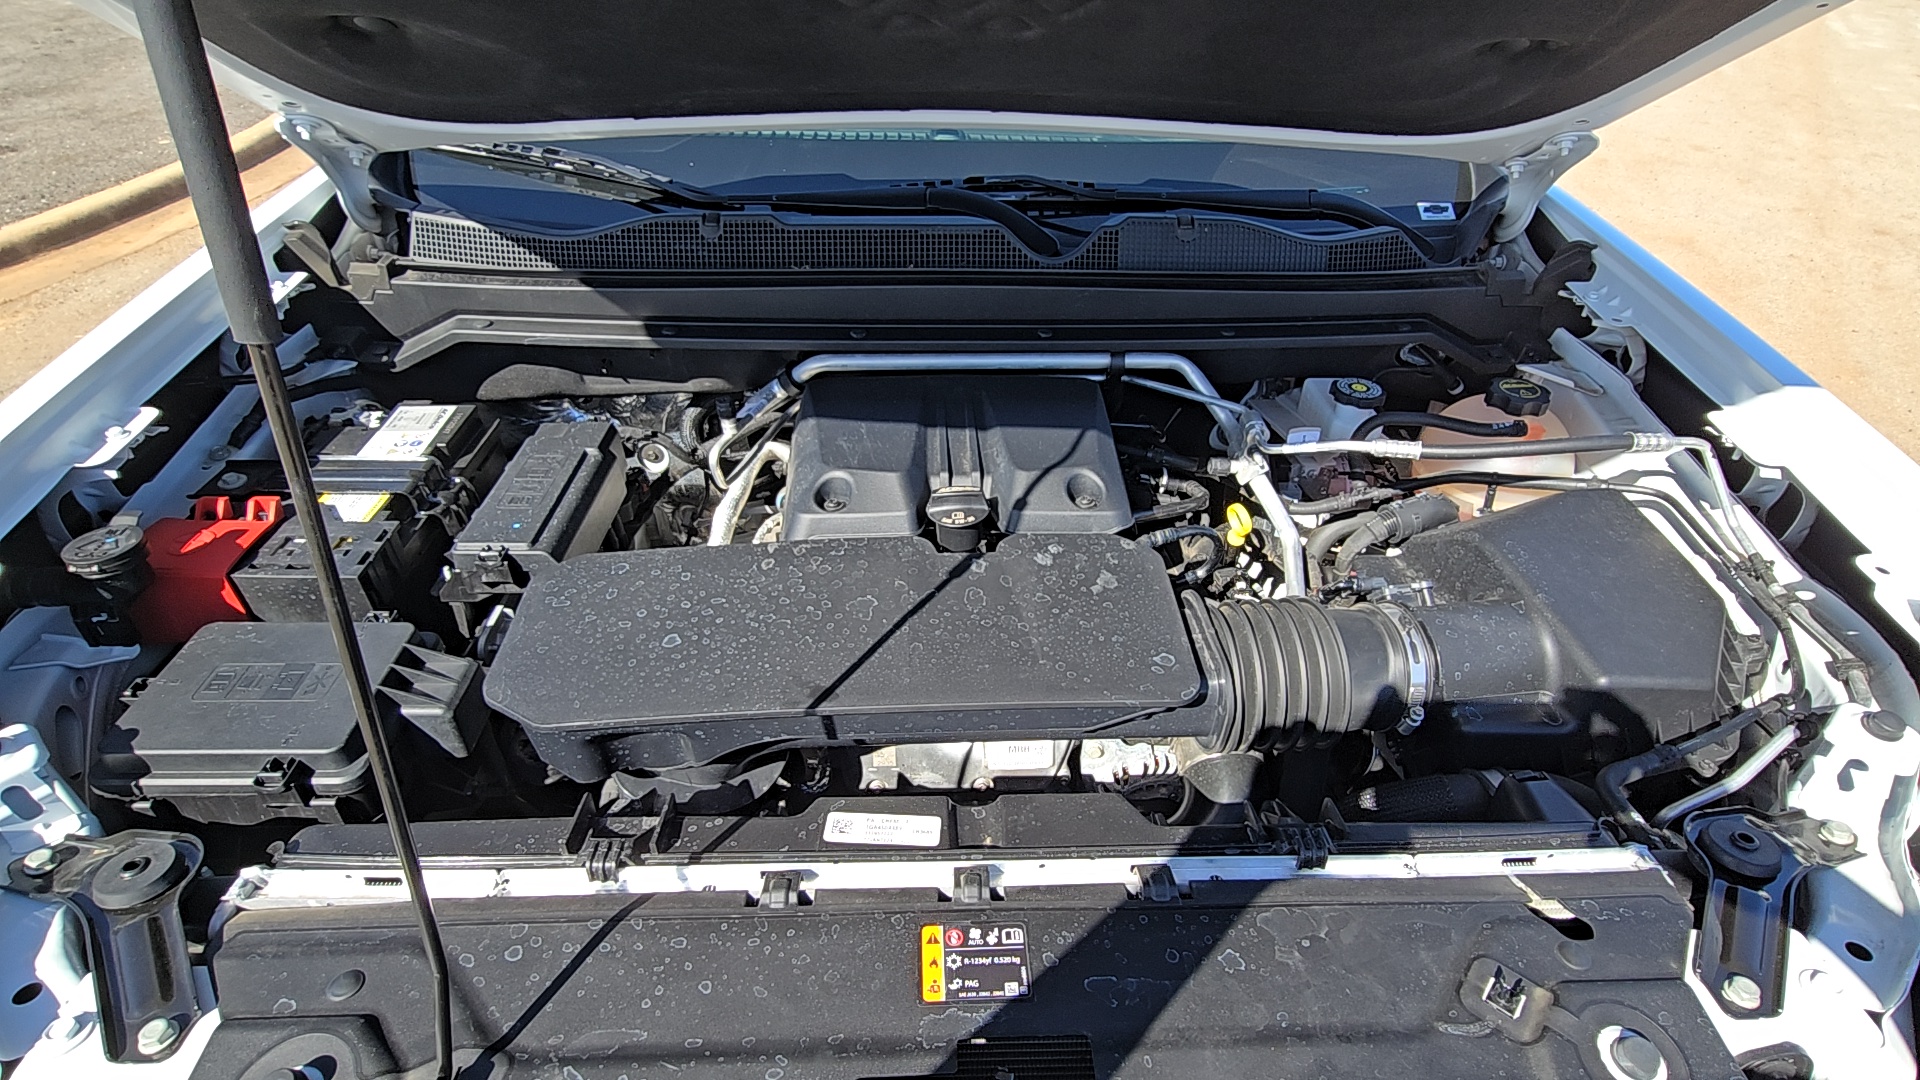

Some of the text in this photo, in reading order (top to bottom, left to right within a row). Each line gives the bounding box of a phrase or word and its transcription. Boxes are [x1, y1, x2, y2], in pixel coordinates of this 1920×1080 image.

[964, 955, 1021, 966] R-1234yf 0.520 kg
[964, 979, 979, 988] PAG
